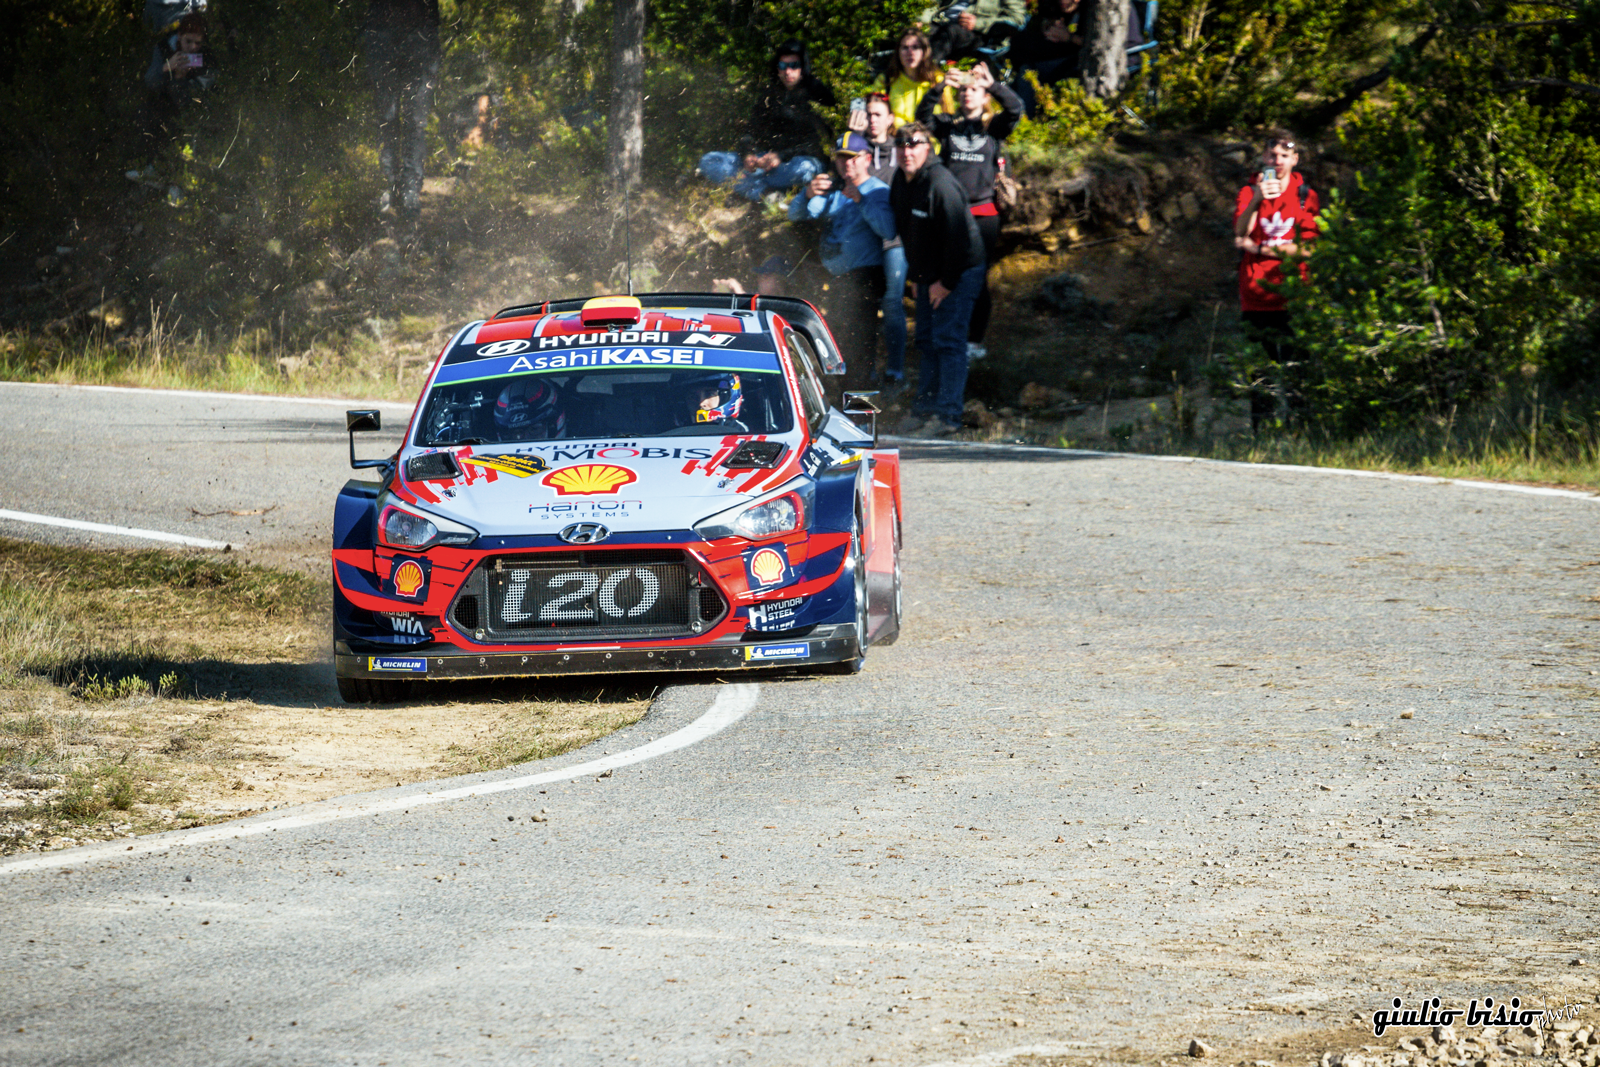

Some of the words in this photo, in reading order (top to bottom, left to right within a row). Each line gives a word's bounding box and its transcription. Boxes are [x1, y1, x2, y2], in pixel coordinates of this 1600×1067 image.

[539, 331, 669, 348] HYUNDAI
[515, 442, 638, 454] HYUNDAI
[551, 447, 713, 462] MOBIS
[541, 511, 630, 520] SYSTEMS
[501, 567, 660, 622] i20
[766, 596, 803, 612] HYUNDAI
[768, 608, 795, 621] STEEL
[391, 616, 426, 636] WIA
[764, 647, 806, 656] MICHELIN
